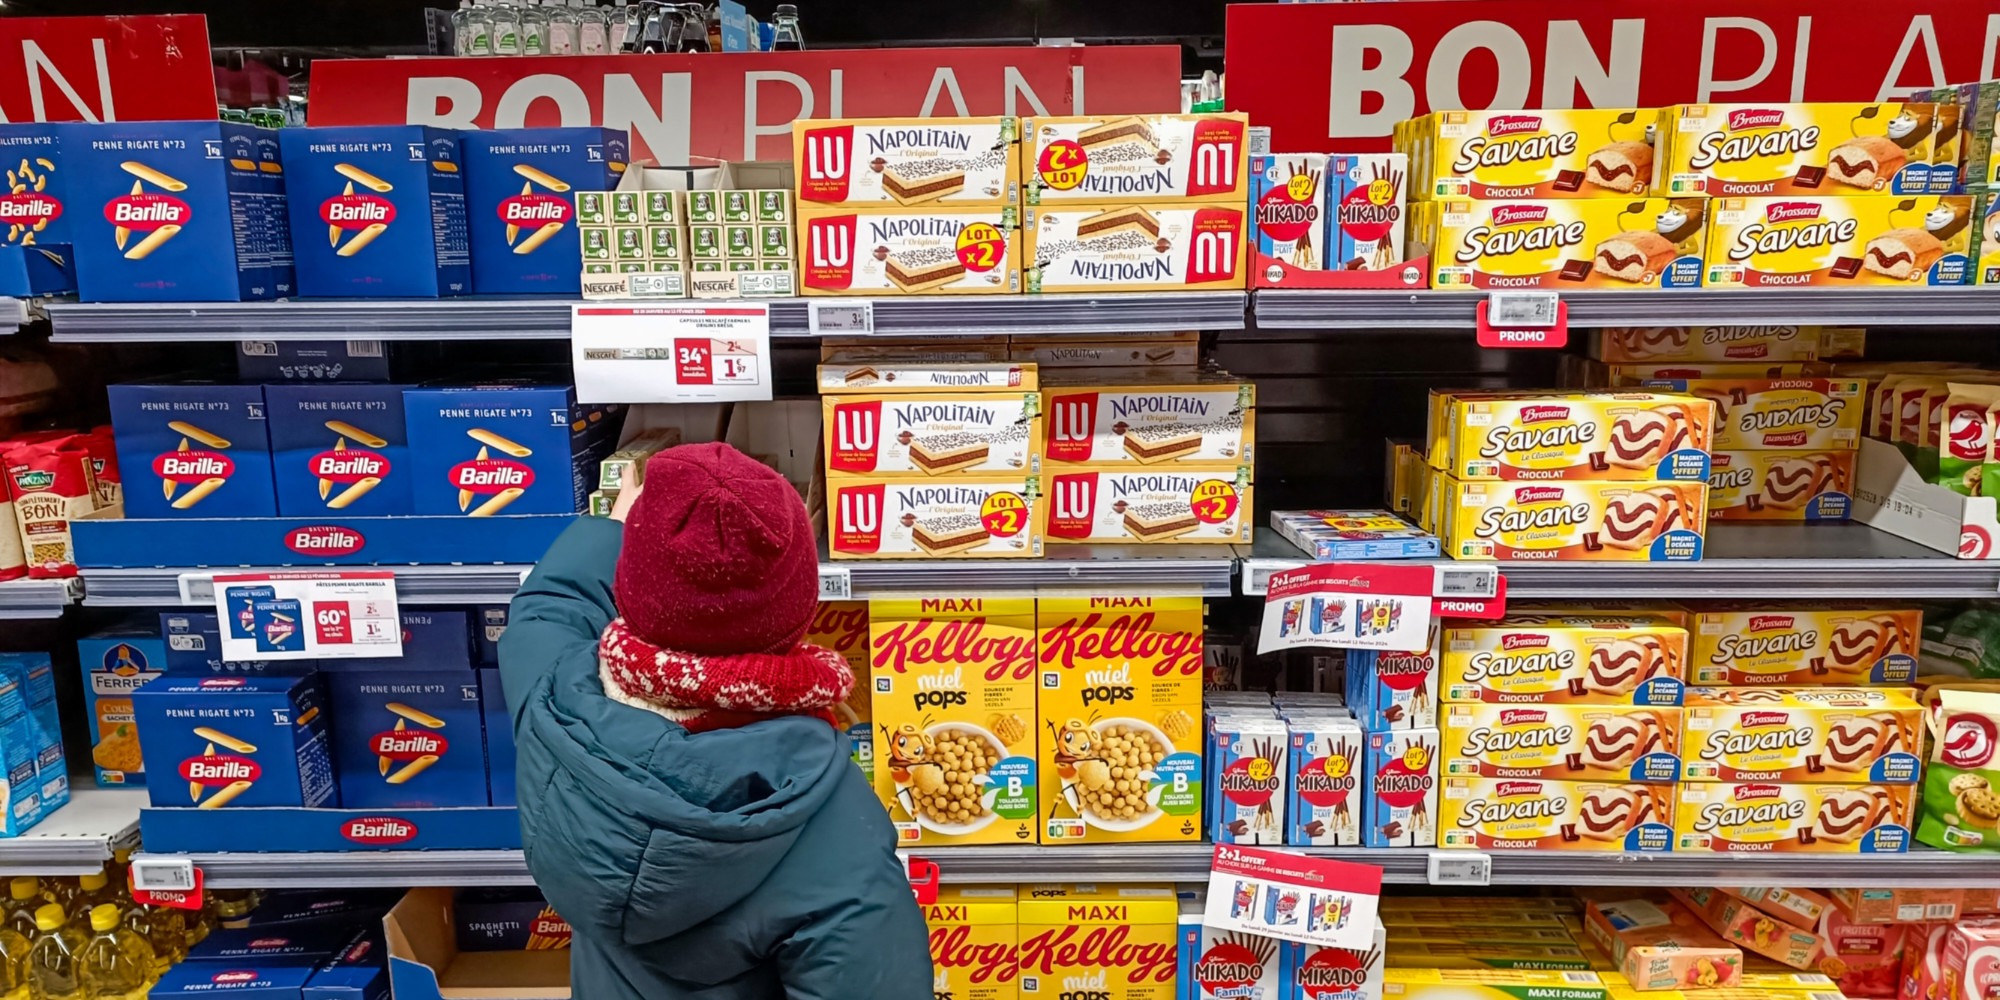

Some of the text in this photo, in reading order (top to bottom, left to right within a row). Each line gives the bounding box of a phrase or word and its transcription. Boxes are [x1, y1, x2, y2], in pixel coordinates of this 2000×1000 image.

[1329, 18, 1645, 139] BON
[406, 72, 692, 166] BON
[1492, 116, 1540, 135] Brossard
[1732, 111, 1782, 130] Brossard
[93, 141, 122, 150] PENNE
[127, 140, 159, 150] RIGATE
[310, 144, 338, 153] PENNE
[340, 144, 368, 152] RIGATE
[489, 146, 516, 154] PENNE
[520, 145, 548, 154] RIGATE
[1454, 132, 1578, 173] Savane
[1691, 126, 1820, 168] Savane
[808, 136, 845, 180] LU
[1050, 146, 1077, 170] x2
[1196, 143, 1233, 186] LU
[1254, 161, 1262, 172] LU
[1337, 161, 1346, 172] LU
[1050, 172, 1077, 183] LOT
[1290, 178, 1303, 188] Lot
[1900, 182, 1926, 190] OFFERT
[1485, 187, 1534, 198] CHOCOLAT
[1723, 183, 1774, 194] CHOCOLAT
[0, 200, 53, 216] Barilla
[115, 202, 180, 221] Barilla
[329, 203, 386, 220] Barilla
[506, 202, 561, 220] Barilla
[1255, 204, 1318, 224] MIKADO
[1337, 204, 1400, 224] MIKADO
[1498, 207, 1547, 225] Brossard
[1769, 203, 1820, 222] Brossard
[966, 230, 992, 240] LOT
[1456, 222, 1584, 262] Savane
[1730, 218, 1856, 259] Savane
[812, 225, 848, 267] LU
[966, 242, 994, 267] x2
[1196, 232, 1232, 274] LU
[584, 280, 627, 293] NESCAFÉ
[693, 278, 736, 292] NESCAFÉ
[1490, 276, 1540, 286] CHOCOLAT
[1671, 274, 1697, 283] OFFERT
[1760, 274, 1811, 284] CHOCOLAT
[1499, 330, 1545, 342] PROMO
[680, 348, 710, 364] 34%
[142, 402, 204, 410] PENNE RIGATE
[299, 402, 362, 410] PENNE RIGATE
[440, 409, 507, 418] PENNE RIGATE
[1522, 406, 1568, 423] Brossard
[1056, 402, 1088, 440] LU
[1740, 401, 1844, 432] Savane
[838, 410, 874, 450] LU
[1480, 422, 1596, 458] Savane
[163, 458, 224, 474] Barilla
[319, 457, 380, 474] Barilla
[460, 468, 523, 485] Barilla
[1516, 470, 1564, 480] CHOCOLAT
[1056, 481, 1090, 518] LU
[1201, 486, 1226, 496] LOT
[1517, 488, 1562, 504] Brossard
[990, 498, 1015, 508] LOT
[1200, 498, 1228, 518] x2
[841, 493, 878, 532] LU
[990, 510, 1018, 532] x2
[1474, 503, 1589, 538] Savane
[295, 532, 355, 548] Barilla
[1511, 550, 1559, 559] CHOCOLAT
[1272, 576, 1289, 588] 2+1
[921, 598, 982, 612] MAXI
[1090, 598, 1152, 608] MAXI
[1440, 602, 1484, 612] PROMO
[318, 610, 346, 626] 60%
[1504, 634, 1548, 650] Brossard
[1711, 630, 1818, 664] Savane
[1085, 662, 1132, 686] miel
[1376, 656, 1434, 676] MIKADO
[1463, 650, 1574, 683] Savane
[917, 667, 964, 690] miel
[360, 685, 420, 694] PENNE RIGATE
[166, 709, 230, 718] PENNE RIGATE
[1502, 710, 1546, 724] Brossard
[380, 736, 438, 752] Barilla
[1462, 726, 1572, 757] Savane
[1700, 726, 1813, 760] Savane
[190, 762, 250, 779] Barilla
[1008, 777, 1023, 797] B
[1173, 773, 1188, 792] B
[1220, 773, 1280, 792] MIKADO
[1296, 775, 1356, 792] MIKADO
[1374, 774, 1433, 792] MIKADO
[1458, 796, 1566, 828] Savane
[1694, 799, 1806, 832] Savane
[350, 822, 408, 837] Barilla
[1218, 848, 1240, 860] 2+1
[150, 891, 186, 904] PROMO
[1068, 906, 1127, 920] MAXI
[468, 922, 520, 931] SPAGHETTI
[1188, 932, 1196, 942] LU
[1063, 970, 1108, 990] miel
[1195, 962, 1264, 982] MIKADO
[1298, 968, 1367, 986] MIKADO
[1216, 986, 1254, 1000] Family
[1528, 988, 1602, 998] MAXI FORMAT
